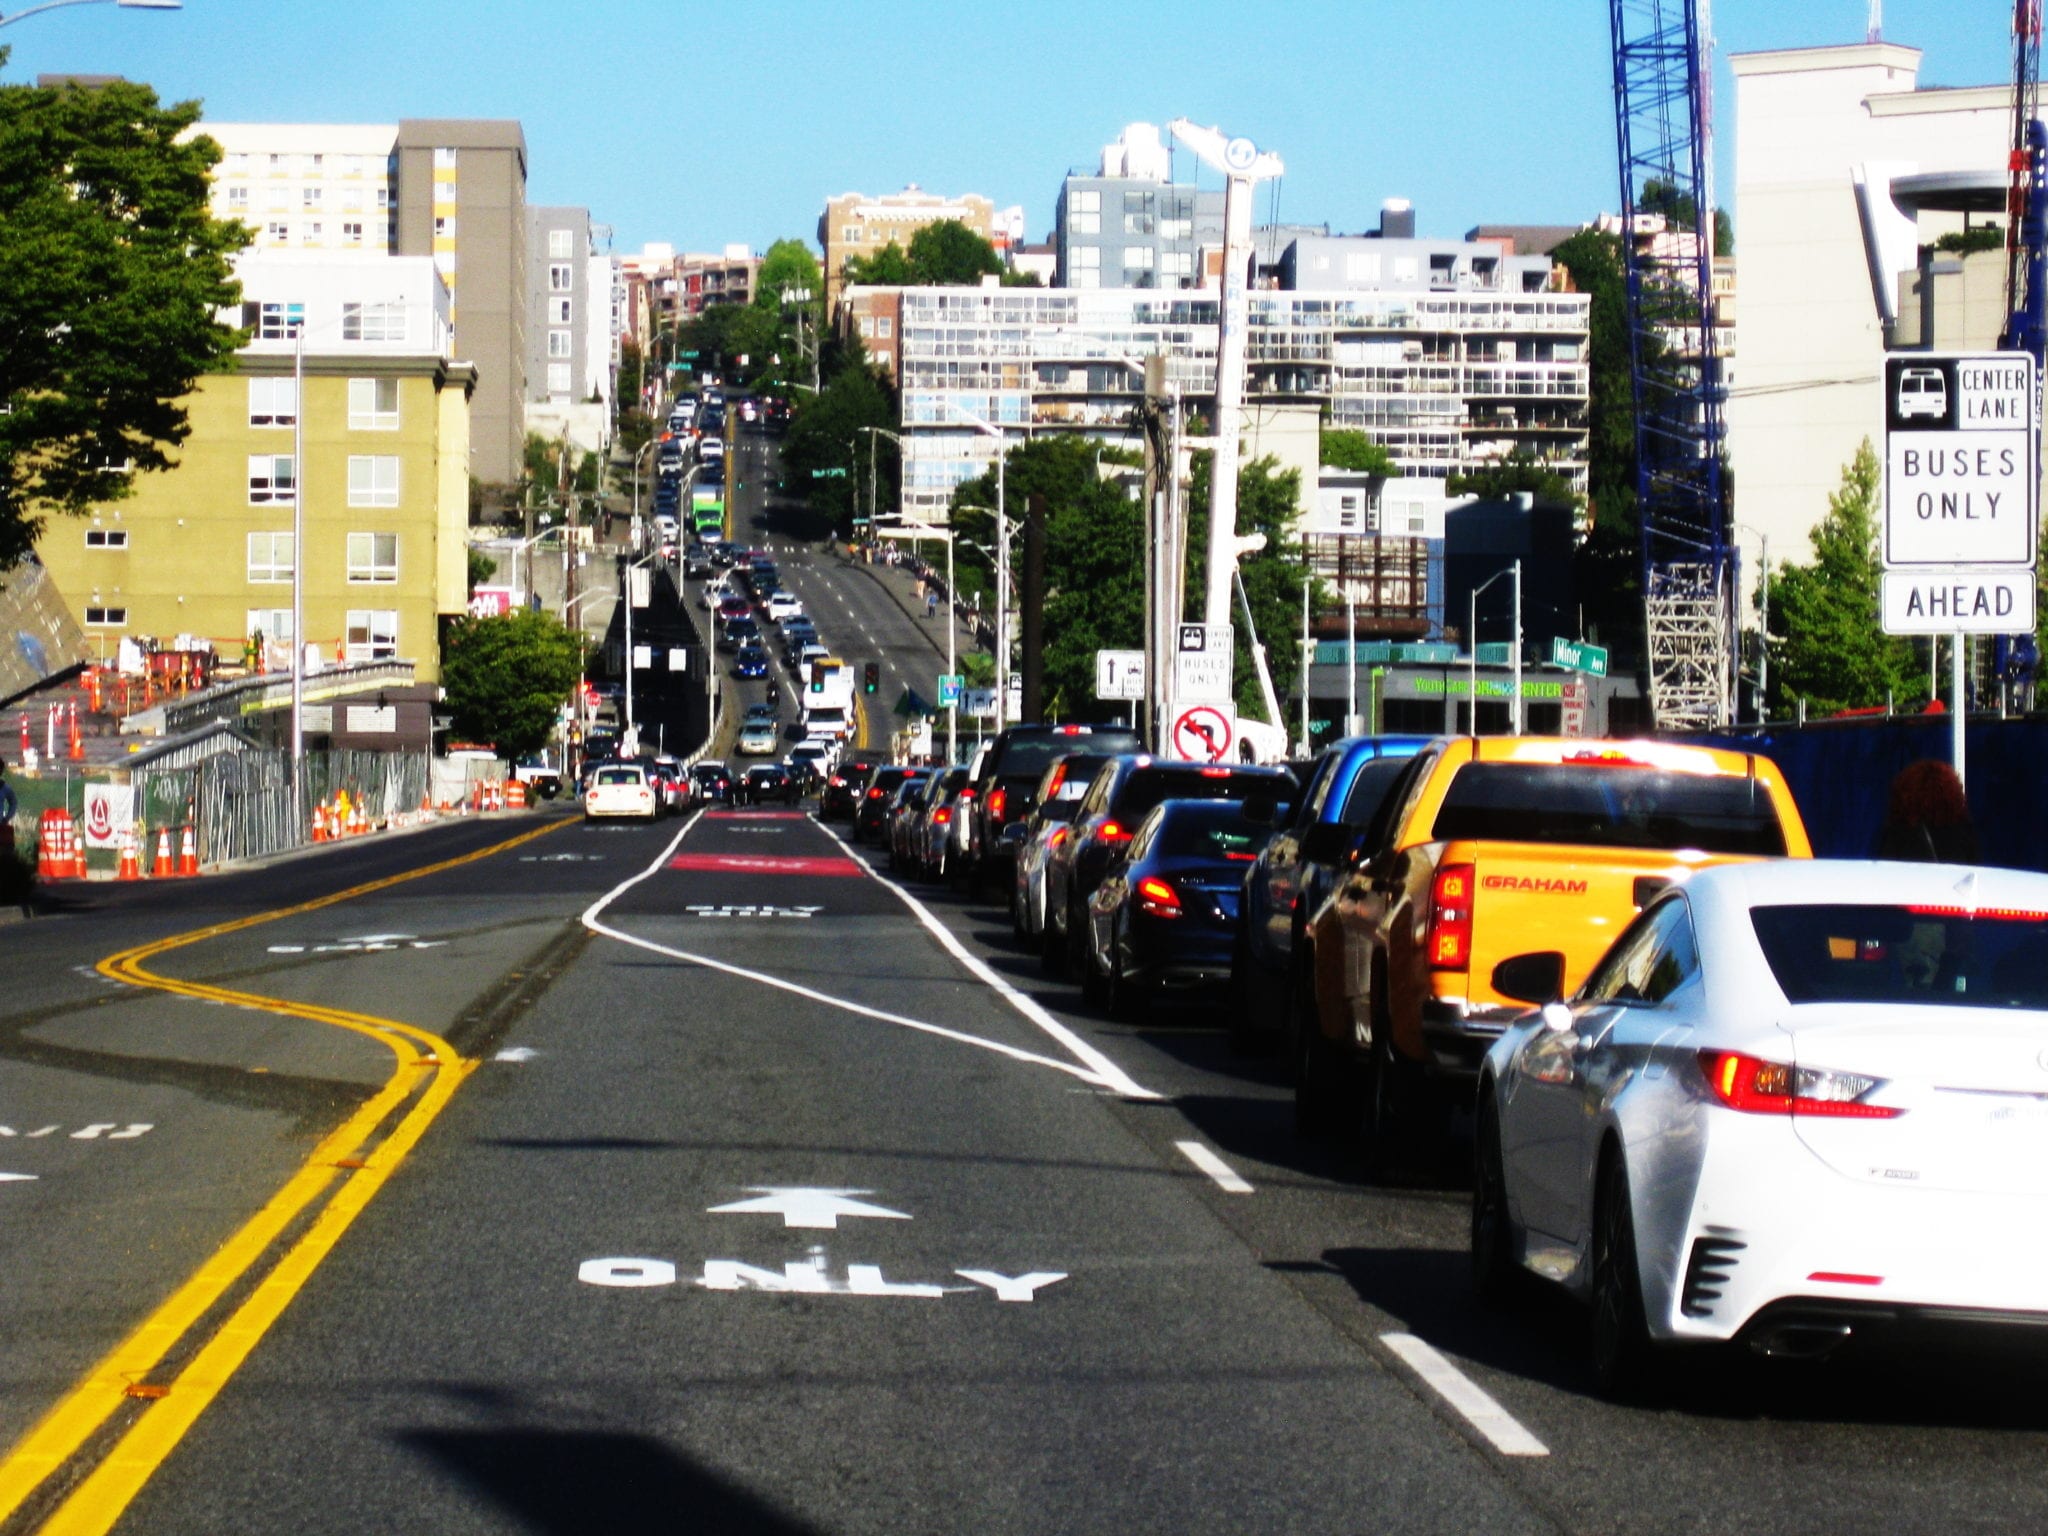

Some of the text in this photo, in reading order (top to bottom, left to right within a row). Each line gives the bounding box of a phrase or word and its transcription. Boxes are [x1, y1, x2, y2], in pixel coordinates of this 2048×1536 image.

[1962, 369, 2025, 391] CENTER
[1967, 397, 2019, 419] LANE
[1904, 449, 2015, 477] BUSES
[1916, 492, 2001, 519] ONLY
[1906, 586, 2014, 617] AHEAD
[1184, 659, 1225, 669] BUSES
[1556, 643, 1604, 672] Minor Ave
[1189, 674, 1219, 685] ONLY
[1563, 685, 1575, 697] NO
[1484, 875, 1588, 892] GRAHAM
[578, 1255, 1069, 1302] ONLY
